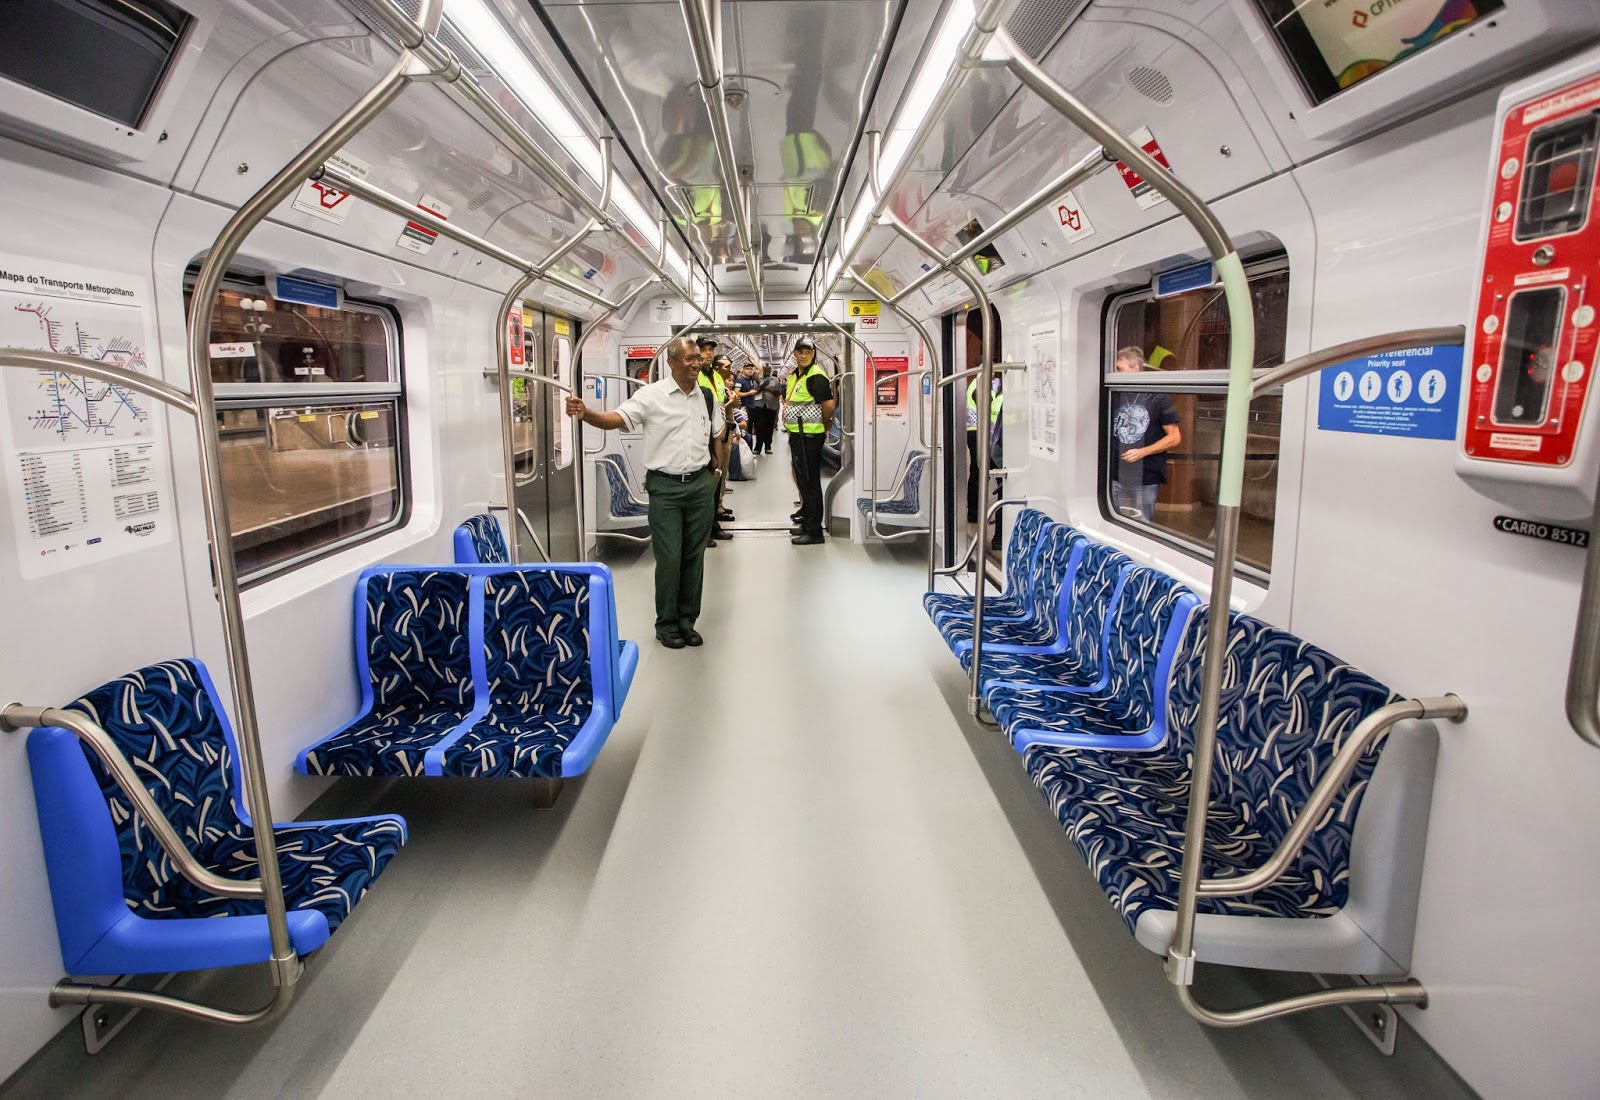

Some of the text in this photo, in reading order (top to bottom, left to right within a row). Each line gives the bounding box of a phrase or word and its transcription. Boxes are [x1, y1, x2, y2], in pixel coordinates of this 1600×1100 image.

[0, 271, 134, 297] Mapa do Transporte Metropolitano
[1367, 360, 1390, 369] Priority
[1502, 519, 1586, 545] CARRO 8512
